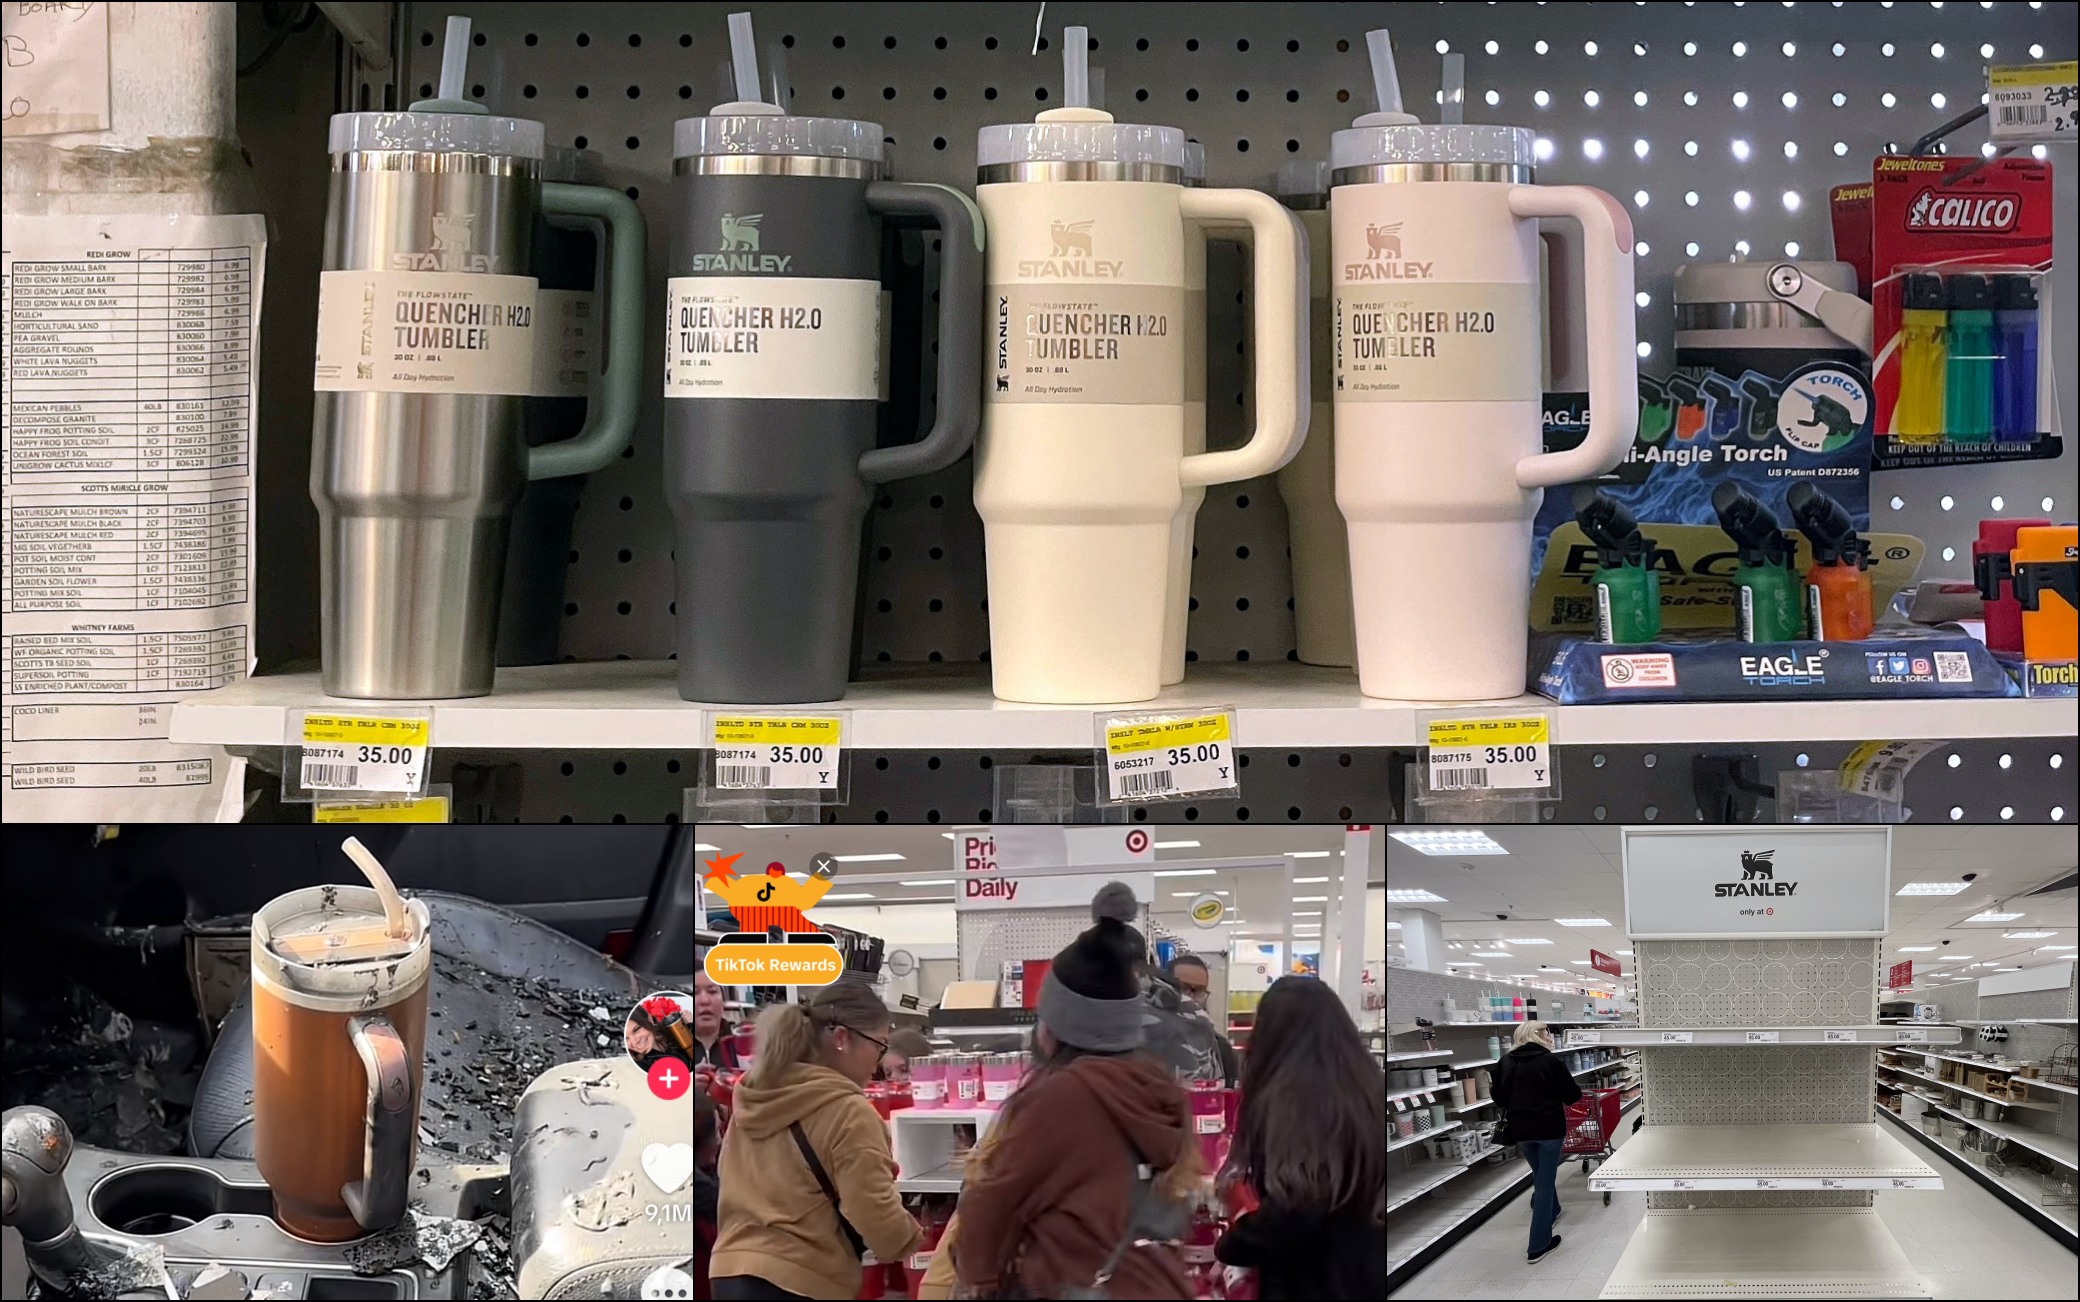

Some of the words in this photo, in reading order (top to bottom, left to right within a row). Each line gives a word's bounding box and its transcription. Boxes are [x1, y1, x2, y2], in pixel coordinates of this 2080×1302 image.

[61, 264, 86, 272] SMALL
[393, 252, 500, 271] STANLEY
[692, 254, 792, 273] STANLEY
[1017, 260, 1124, 279] STANLEY
[1345, 262, 1434, 281] STANLEY
[395, 302, 503, 327] QUENCHER
[506, 305, 531, 327] H2.0
[680, 306, 773, 330] QUENCHER
[780, 307, 822, 330] H2.0
[1353, 312, 1449, 335] QUENCHER
[1455, 311, 1495, 333] H2.0
[999, 296, 1009, 369] STANLEY
[1026, 313, 1131, 336] QUENCHER
[1136, 314, 1167, 337] H2.0
[394, 327, 490, 350] TUMBLER
[680, 331, 759, 354] TUMBLER
[1353, 336, 1436, 359] TUMBLER
[1025, 338, 1118, 360] TUMBLER
[1034, 386, 1047, 394] Day
[1048, 386, 1083, 394] Hydration
[1807, 375, 1862, 400] TORCH
[1542, 410, 1591, 425] AGLE
[41, 450, 70, 458] FOREST
[1720, 444, 1788, 462] Torch
[1767, 468, 1782, 476] US
[1784, 468, 1816, 476] Patent
[1818, 467, 1860, 476] D872356
[1740, 654, 1824, 676] EAGLE
[1743, 676, 1825, 686] TORCH
[358, 746, 412, 764] 35.00
[769, 746, 823, 764] 35.00
[1114, 757, 1154, 770] 6053217
[1167, 743, 1220, 766] 35.00
[1431, 753, 1472, 763] 8087175
[1485, 746, 1537, 764] 35.00
[14, 766, 35, 774] WILD
[56, 765, 75, 773] SEED
[819, 772, 829, 783] Y
[1218, 767, 1229, 778] Y
[1534, 770, 1545, 781] Y
[966, 877, 1018, 900] Daily
[1714, 881, 1799, 898] STANLEY
[1740, 908, 1755, 916] only
